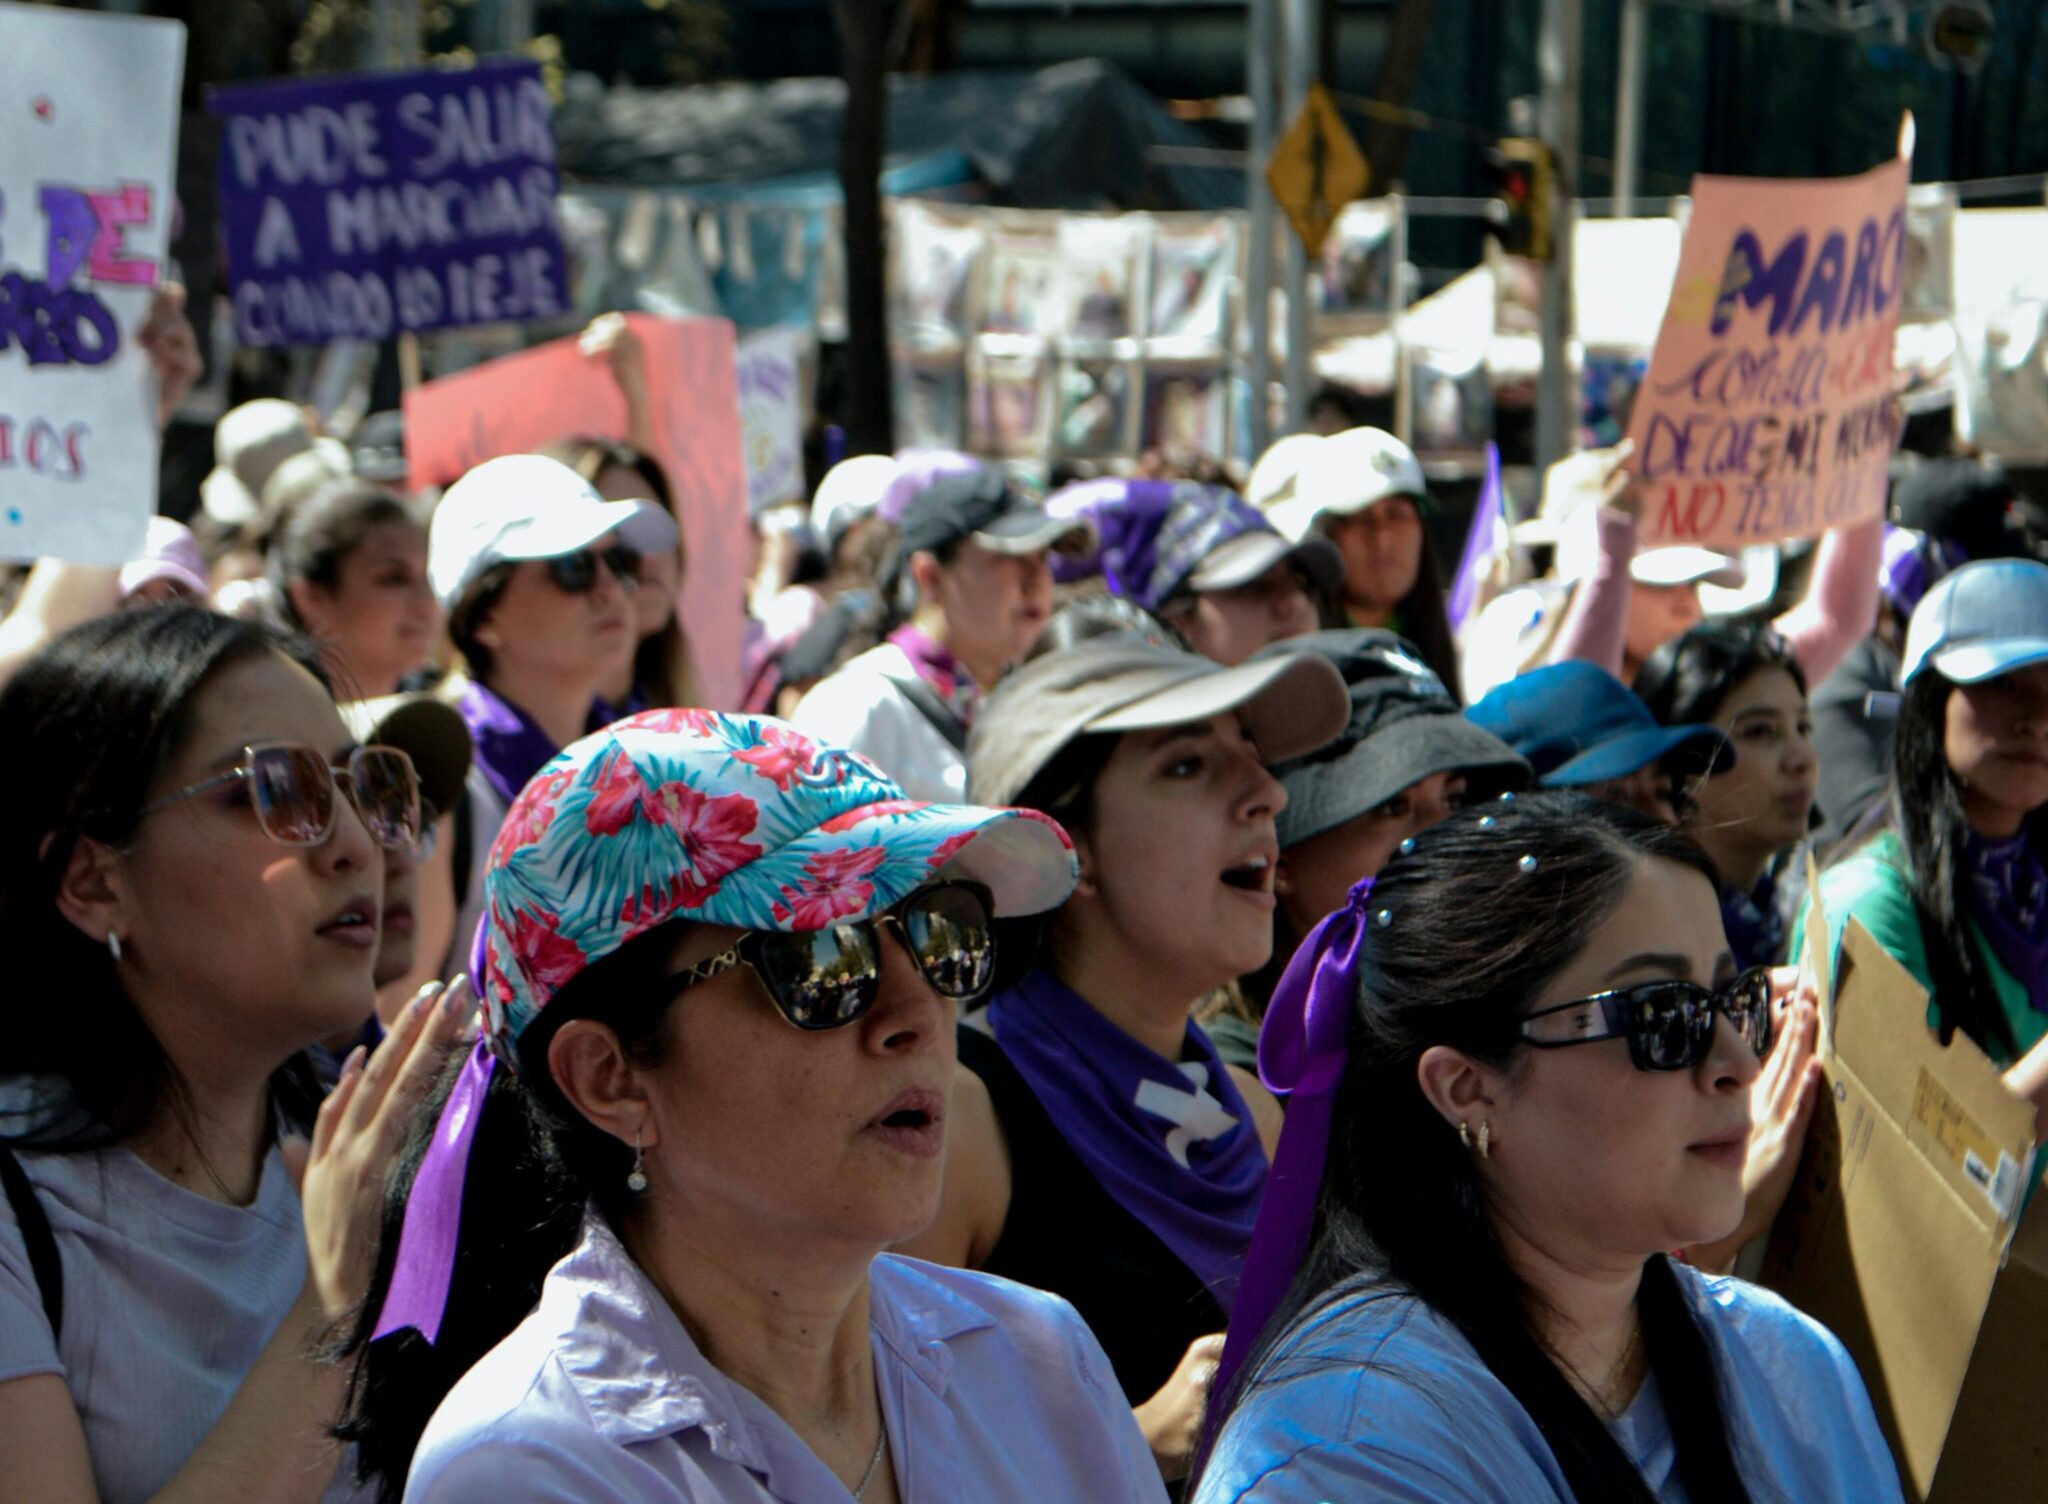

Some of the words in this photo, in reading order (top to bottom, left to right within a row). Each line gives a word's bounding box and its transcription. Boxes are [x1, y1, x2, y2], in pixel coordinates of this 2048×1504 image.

[229, 101, 390, 190] PUDE
[398, 76, 558, 176] SALIR
[254, 194, 302, 268] A
[1655, 478, 1727, 537] NO
